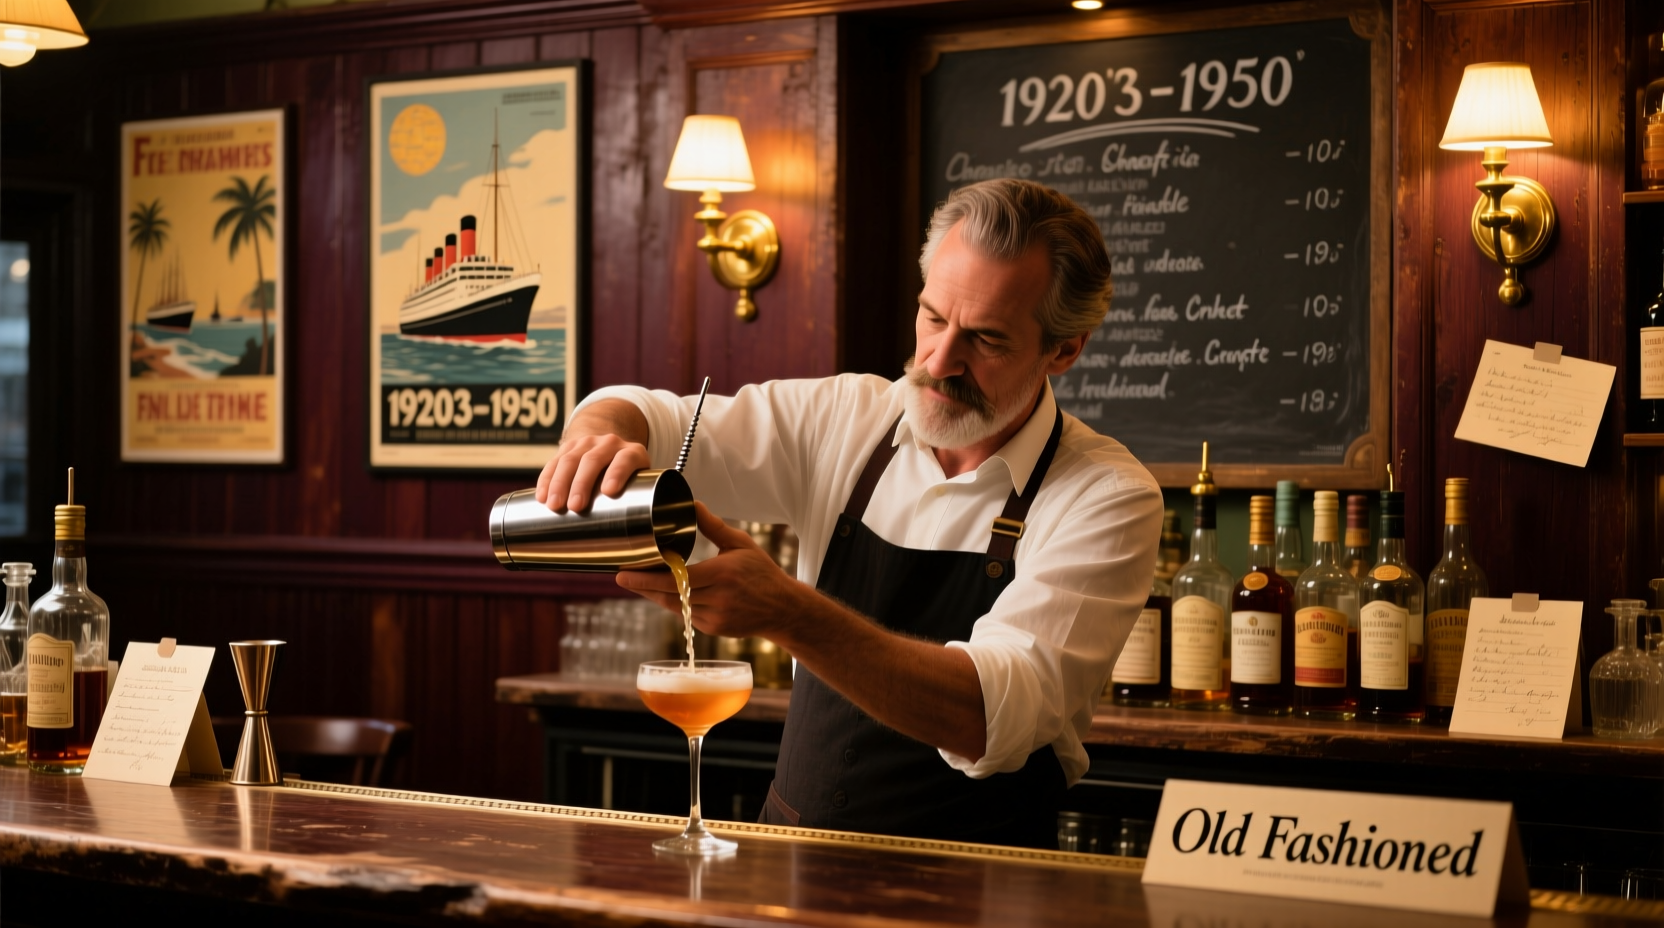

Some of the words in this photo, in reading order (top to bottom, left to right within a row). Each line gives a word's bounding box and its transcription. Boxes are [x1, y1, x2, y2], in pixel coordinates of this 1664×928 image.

[387, 387, 558, 428] 19203-1950
[1172, 807, 1254, 857] Old
[1257, 815, 1485, 878] Fashioned
